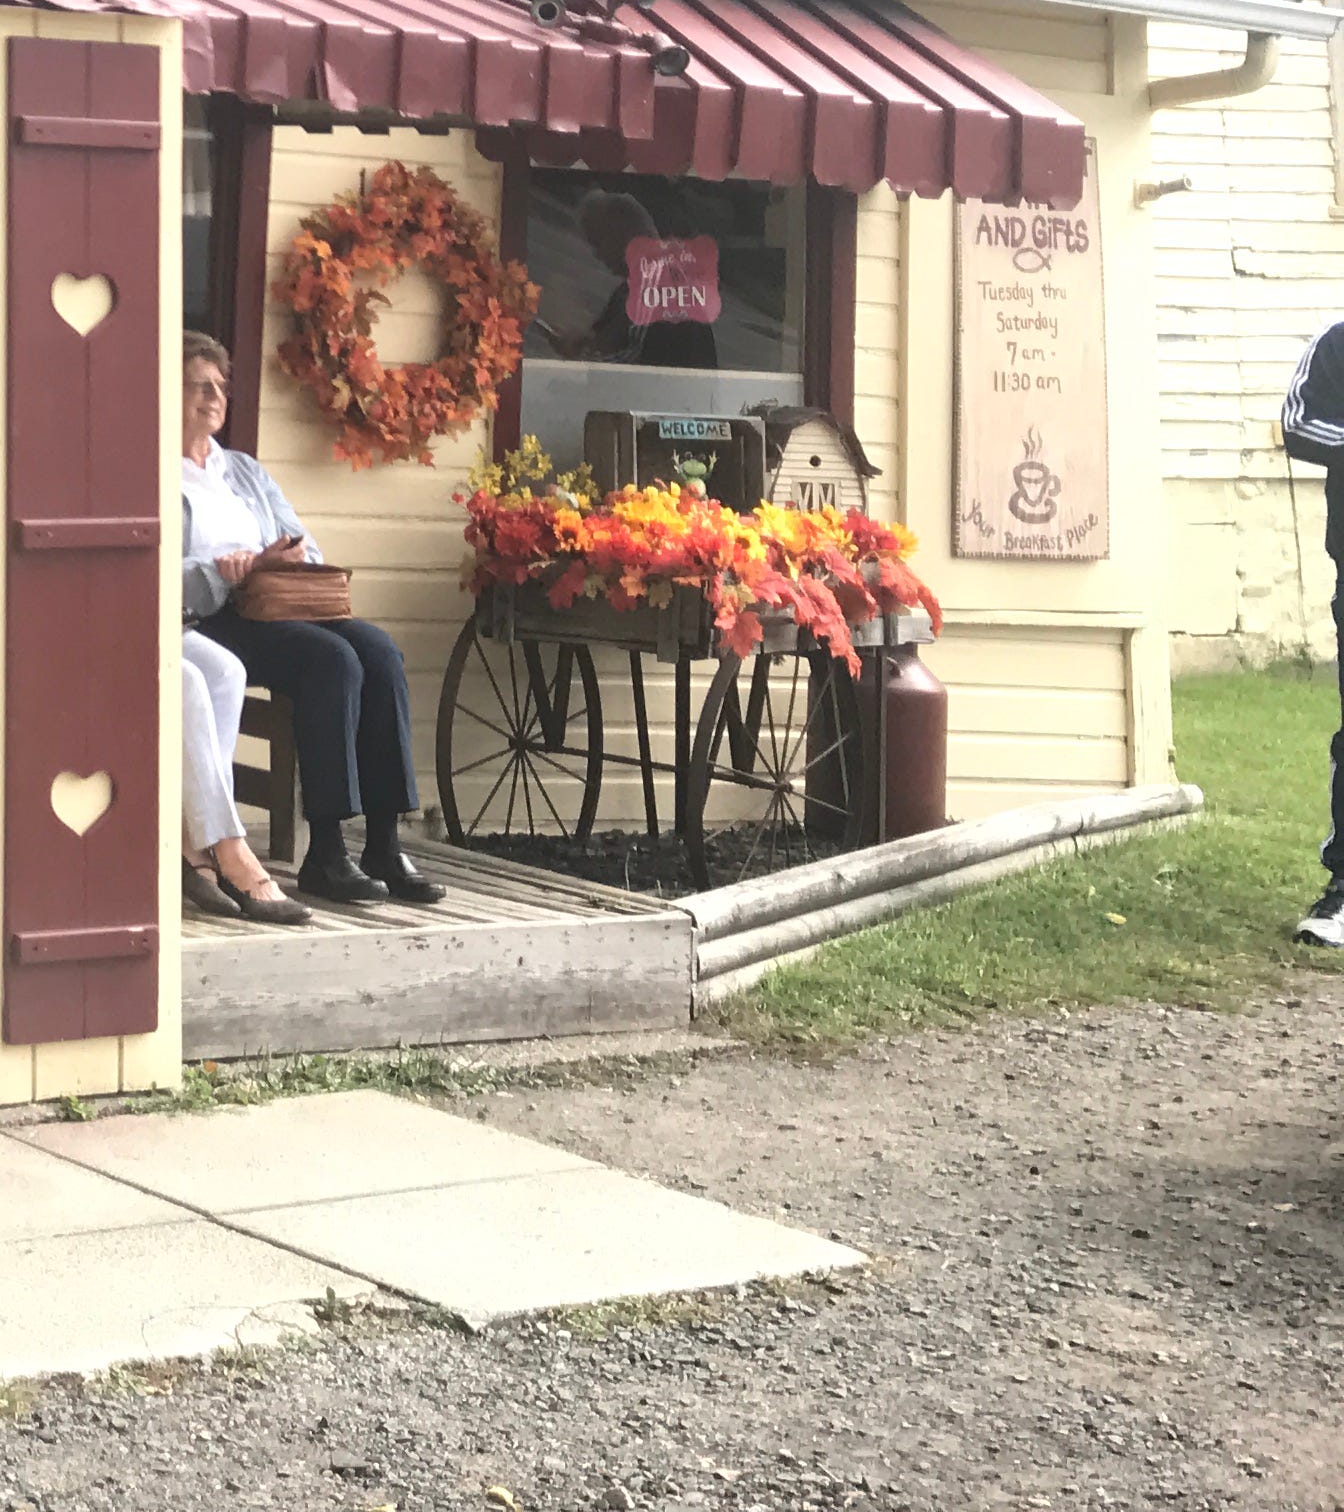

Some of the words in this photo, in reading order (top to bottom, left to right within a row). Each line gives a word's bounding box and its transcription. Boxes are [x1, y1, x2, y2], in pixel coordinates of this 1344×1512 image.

[975, 213, 1027, 249] AND
[643, 285, 707, 308] OPEN
[977, 280, 1034, 308] Tuesday
[1041, 282, 1067, 300] thru
[996, 310, 1058, 339] Saturday
[1006, 341, 1018, 366] 7
[1022, 348, 1046, 362] am
[993, 370, 1031, 393] 11:30
[1036, 375, 1062, 394] am
[661, 420, 729, 437] WELCOME
[961, 498, 996, 539] Your
[1003, 530, 1063, 552] Breakfast
